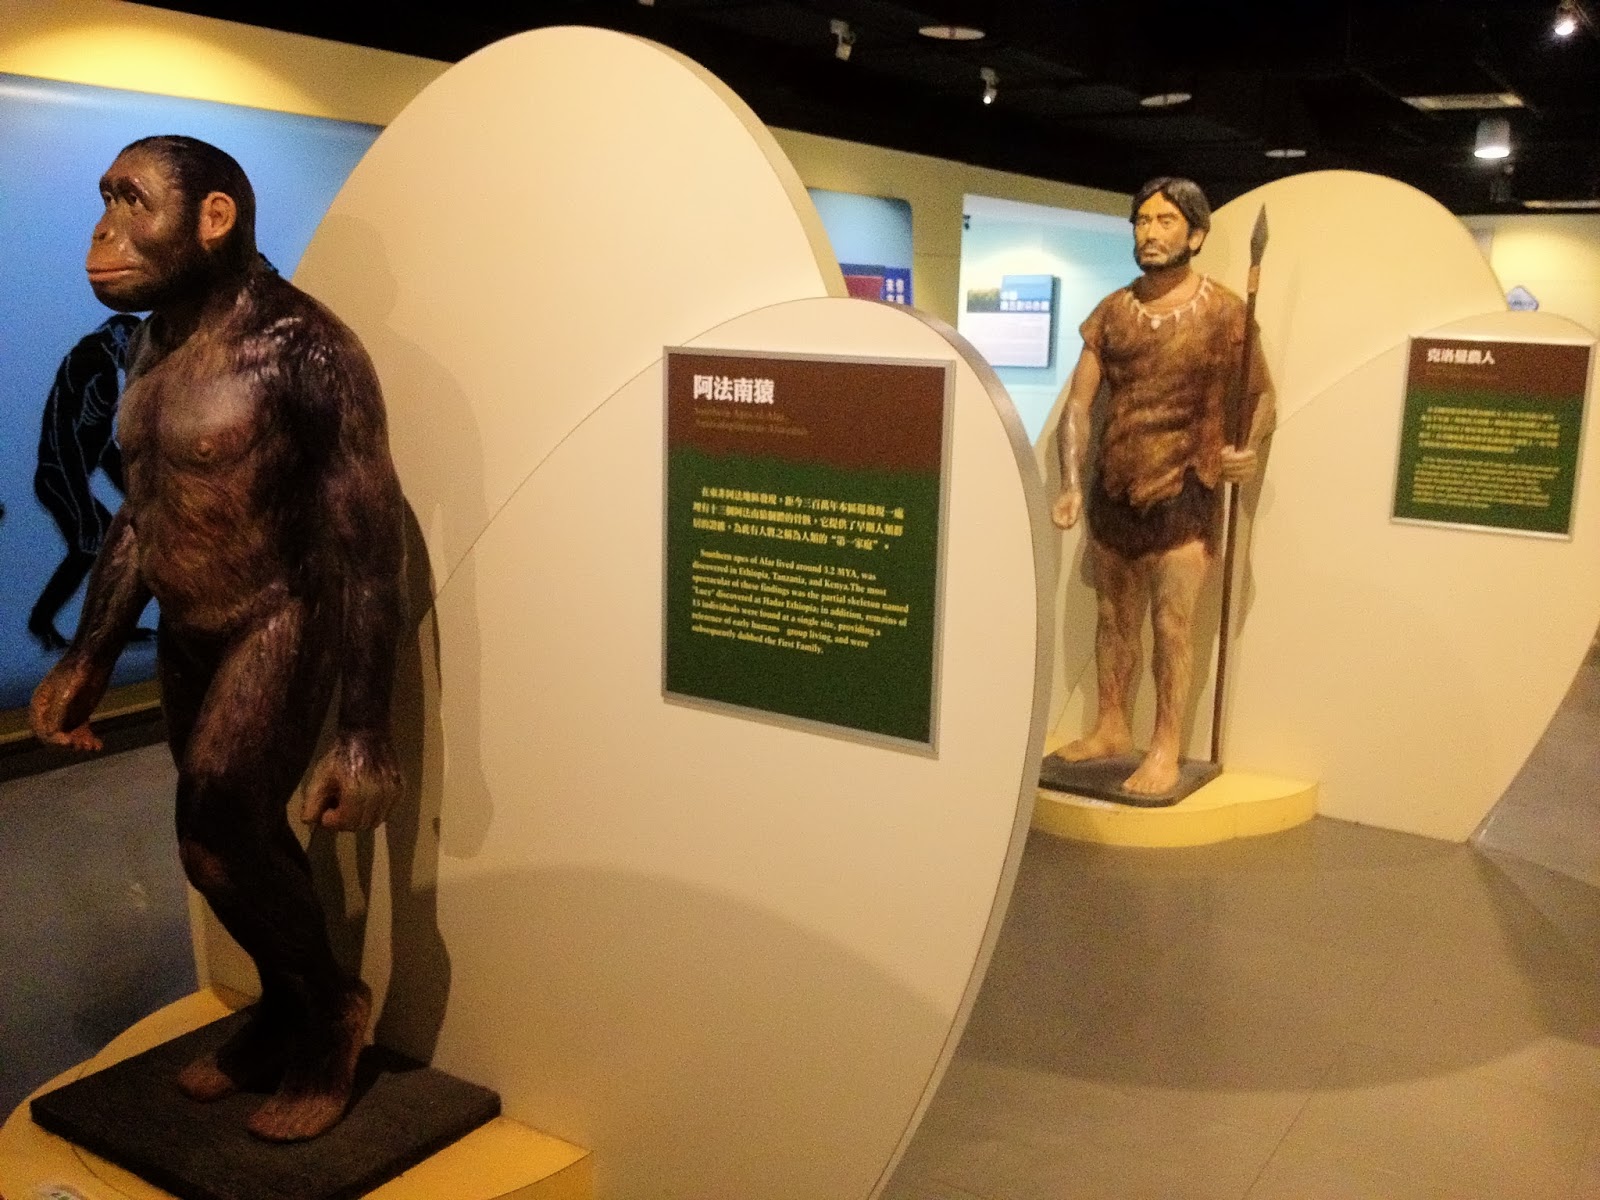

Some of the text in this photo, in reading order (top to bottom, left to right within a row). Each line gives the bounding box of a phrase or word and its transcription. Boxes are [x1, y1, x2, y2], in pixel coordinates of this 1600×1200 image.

[693, 374, 775, 405] 阿法南猿
[692, 561, 728, 573] discovered
[730, 566, 737, 574] in
[739, 567, 771, 580] Ethiopia,
[773, 572, 807, 585] Tanzania,
[867, 586, 887, 596] most
[750, 556, 758, 564] of
[776, 559, 795, 569] lived
[796, 563, 822, 573] around
[716, 590, 753, 602] discovered
[821, 606, 829, 614] in
[831, 608, 864, 621] addition,
[866, 614, 897, 625] remains
[899, 618, 907, 627] of
[761, 583, 790, 596] findings
[808, 591, 820, 599] the
[821, 594, 846, 604] partial
[848, 597, 881, 609] skeleton
[883, 603, 909, 614] named
[742, 608, 759, 616] were
[760, 609, 781, 620] found
[733, 619, 749, 628] early
[787, 629, 808, 639] group
[835, 637, 849, 645] and
[851, 639, 869, 648] were
[765, 636, 776, 645] the
[778, 638, 795, 648] First
[796, 641, 824, 654] Family.
